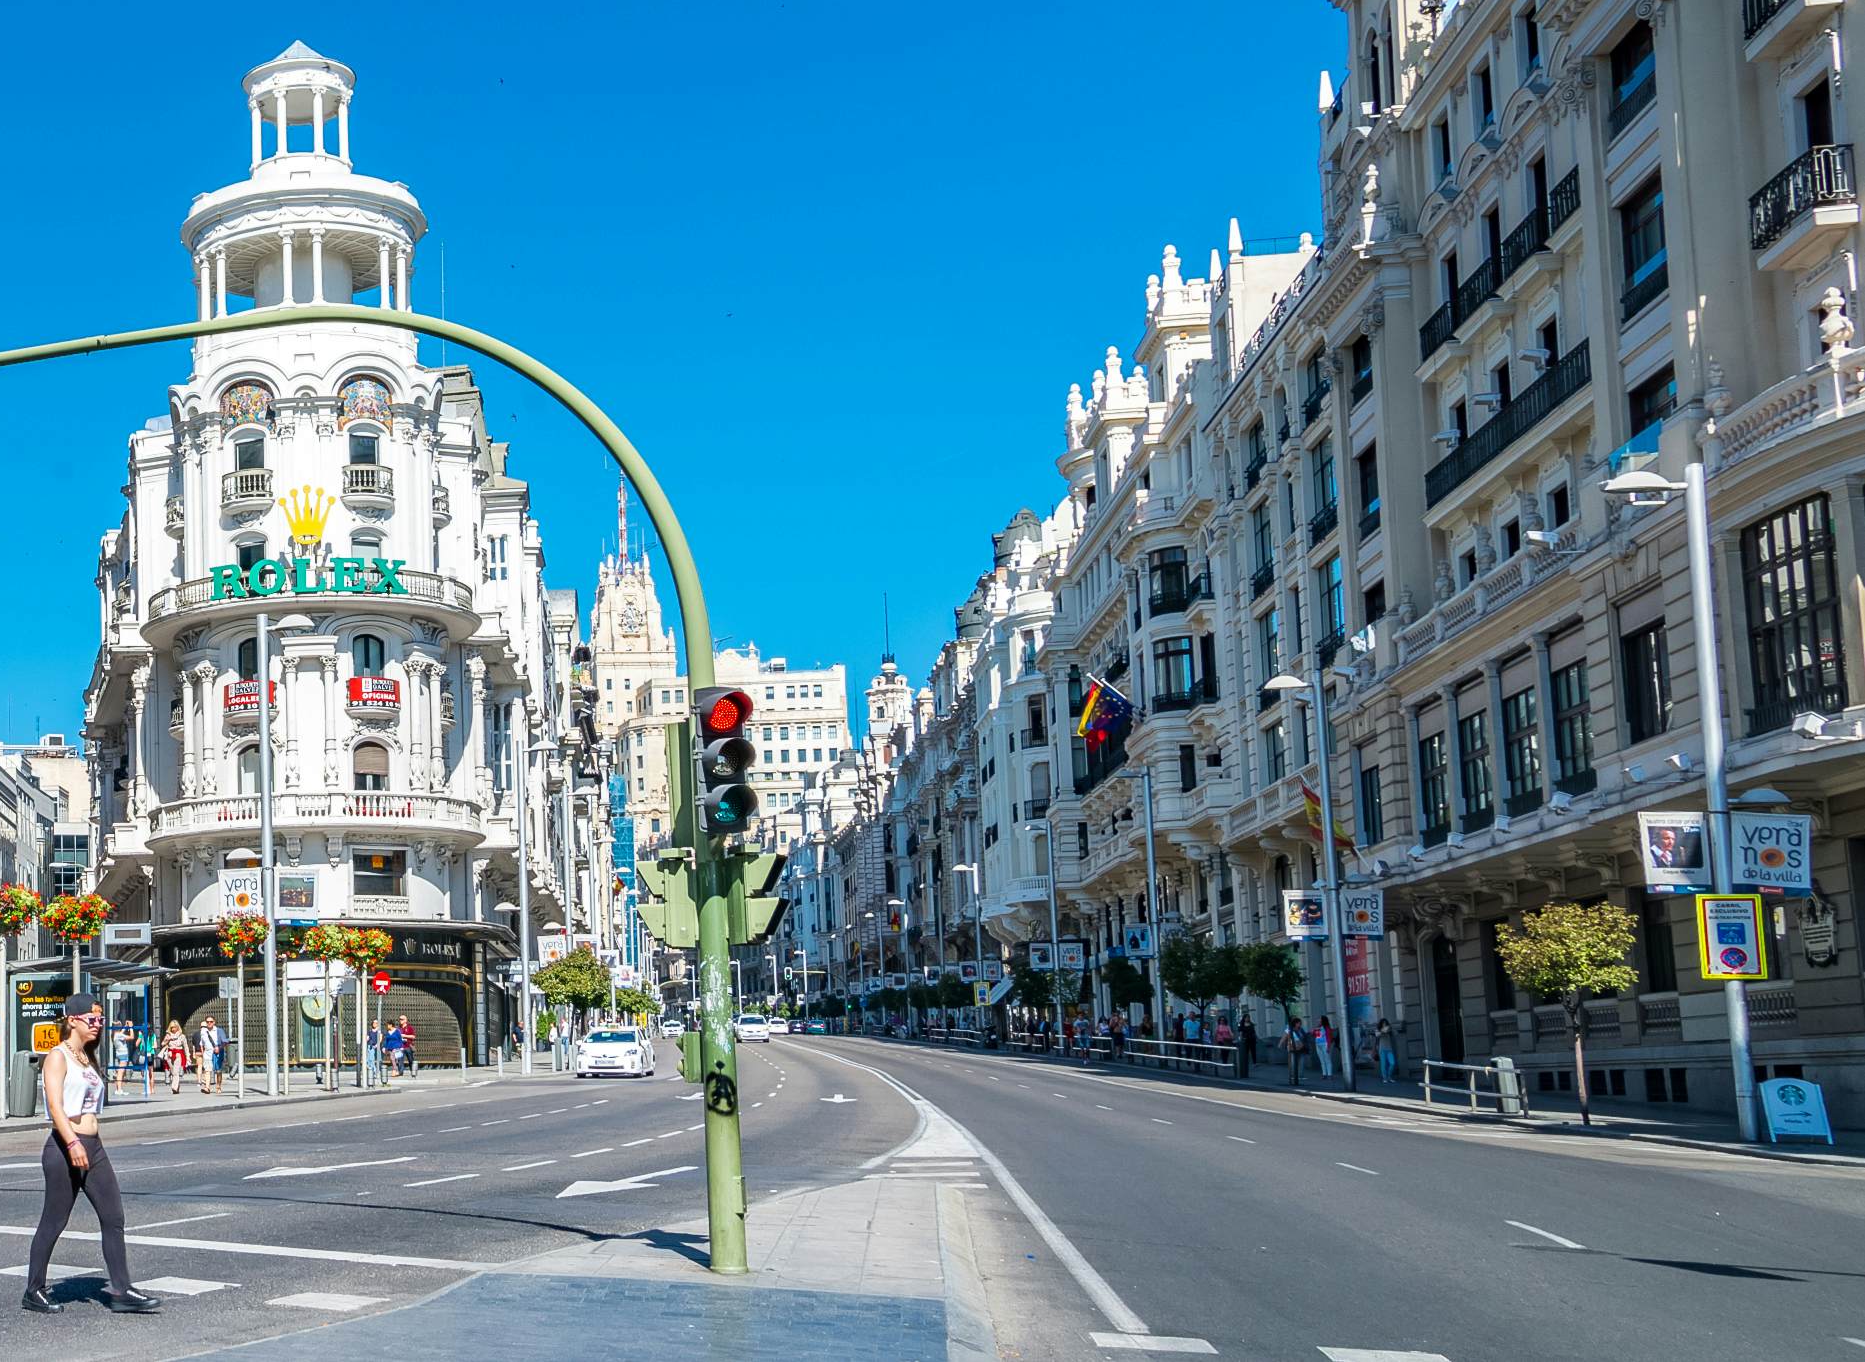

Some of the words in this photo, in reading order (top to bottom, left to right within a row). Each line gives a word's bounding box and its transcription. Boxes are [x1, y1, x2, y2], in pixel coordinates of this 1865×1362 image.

[210, 557, 408, 600] ROLEX
[362, 692, 396, 700] OFICINAS
[1743, 868, 1758, 879] de
[1760, 869, 1771, 881] la
[1773, 870, 1802, 883] villa
[18, 982, 30, 991] 4G
